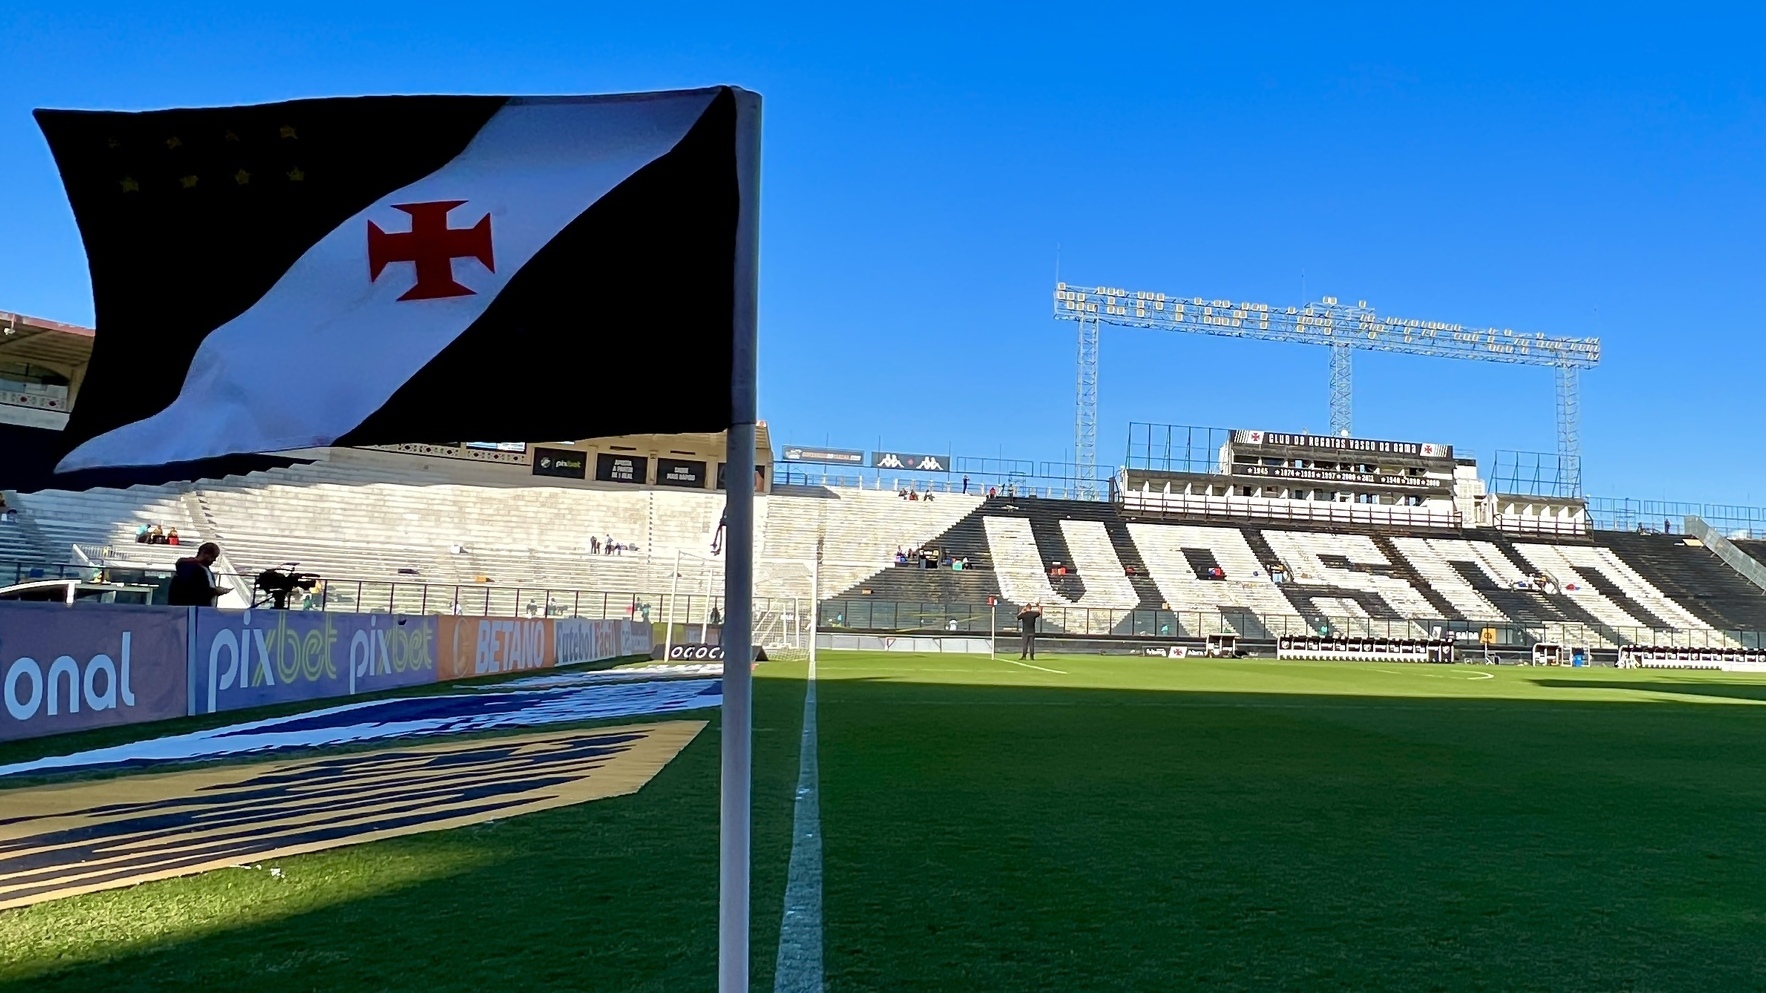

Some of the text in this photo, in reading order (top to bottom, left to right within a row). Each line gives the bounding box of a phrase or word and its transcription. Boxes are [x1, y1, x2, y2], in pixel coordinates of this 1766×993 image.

[555, 460, 581, 468] pixbet
[1294, 435, 1305, 446] DE
[1308, 436, 1346, 449] REGATAS
[1349, 439, 1376, 452] VASCO
[1379, 441, 1390, 452] DA
[1393, 443, 1417, 454] GAMA
[208, 610, 433, 713] pixbet pixbet
[475, 619, 545, 674] BETANO
[555, 621, 592, 664] Futebol
